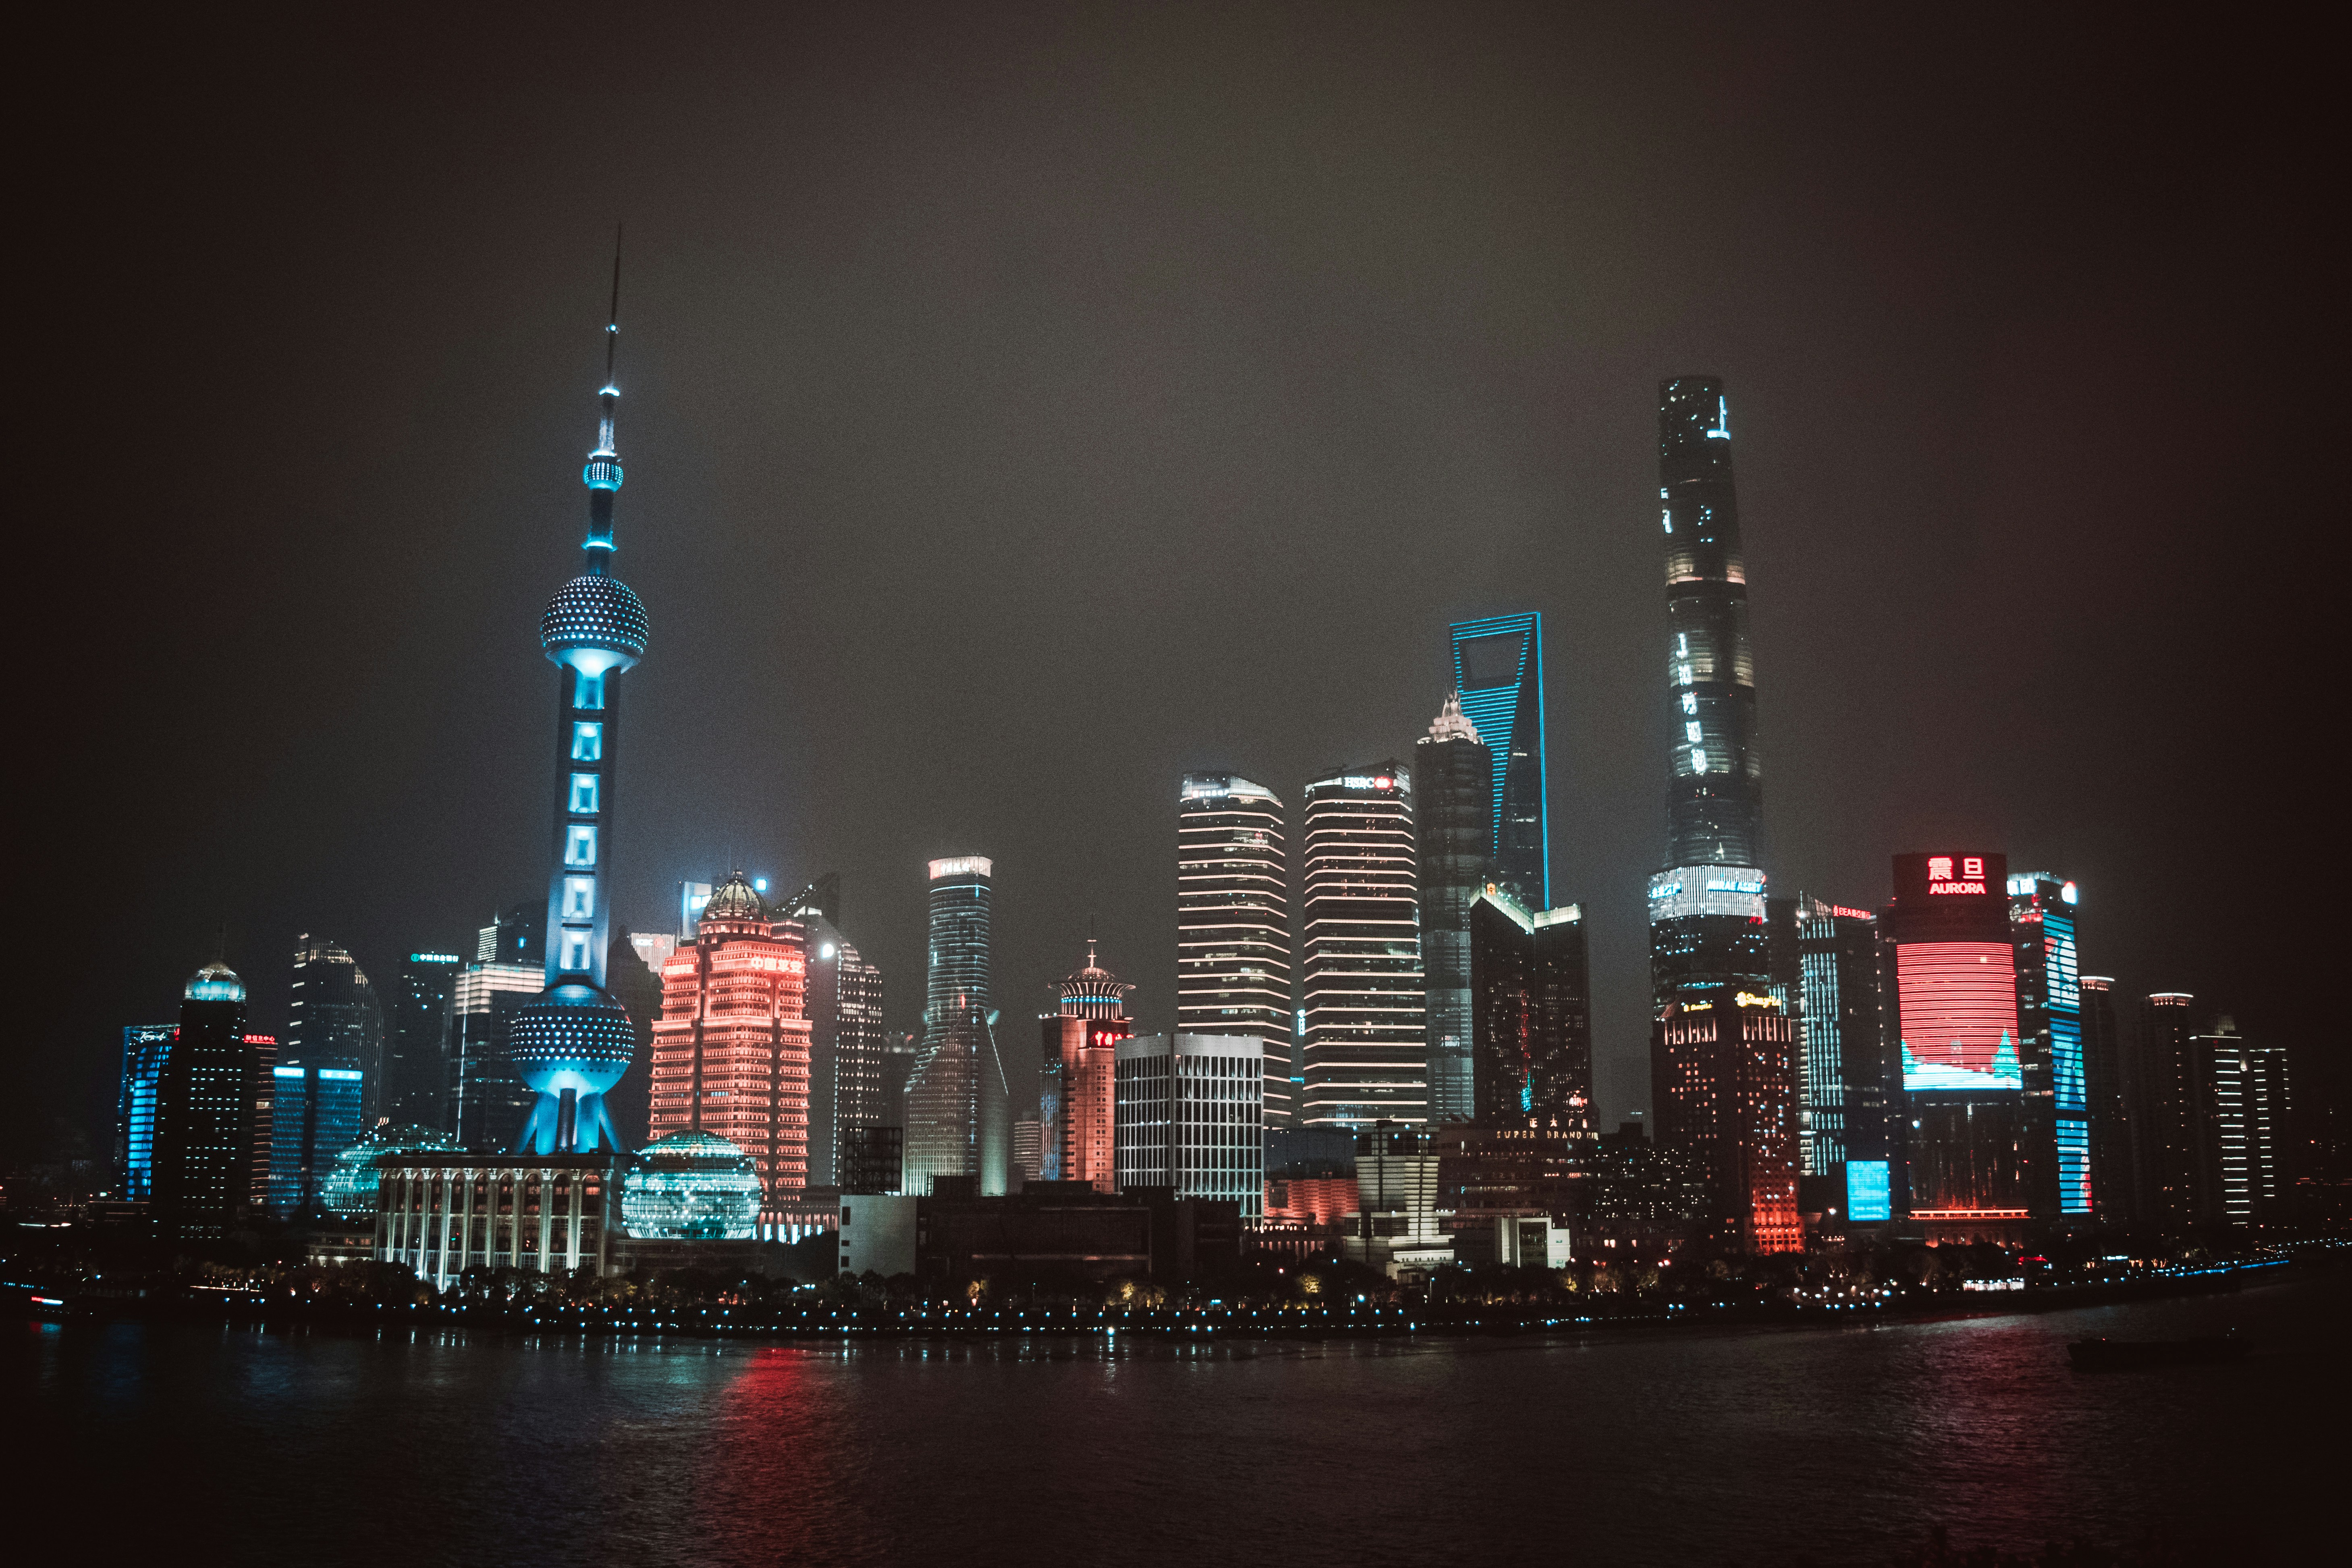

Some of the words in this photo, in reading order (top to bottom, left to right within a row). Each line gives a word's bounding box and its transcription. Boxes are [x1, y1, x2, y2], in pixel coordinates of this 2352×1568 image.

[1344, 777, 1375, 789] HSBC
[1929, 857, 1986, 880] 震旦
[1707, 880, 1737, 892] MIRAE
[1737, 882, 1762, 893] ASSET
[1929, 882, 1986, 895] AURORA
[665, 964, 694, 976] 中国平安
[751, 957, 802, 974] 中国平安
[1497, 1130, 1536, 1139] SUPER
[1547, 1130, 1582, 1140] BRAND
